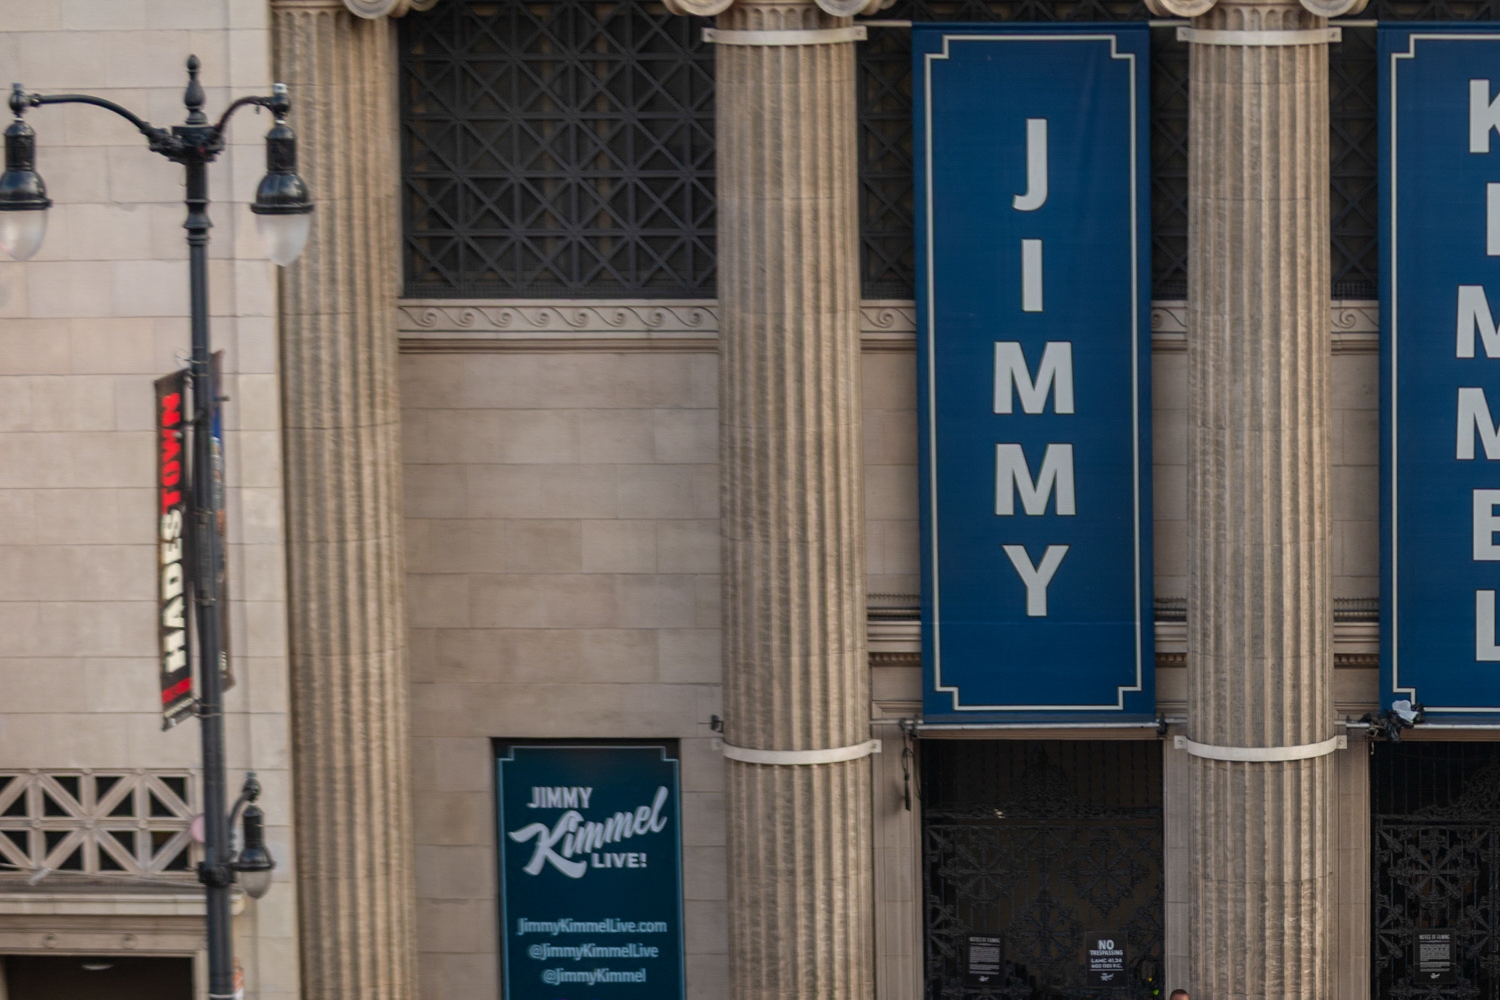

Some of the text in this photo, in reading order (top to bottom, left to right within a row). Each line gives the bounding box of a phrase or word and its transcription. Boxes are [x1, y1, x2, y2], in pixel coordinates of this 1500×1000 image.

[992, 118, 1076, 617] JIMMY
[526, 786, 593, 809] JIMMY
[508, 786, 669, 879] Kimmel
[591, 852, 647, 868] LIVE!
[517, 918, 667, 936] JimmyKimmelLive.com
[528, 943, 659, 961] @JimmyKimmelLive
[1098, 939, 1114, 950] NO
[542, 968, 646, 986] @JimmyKimmel
